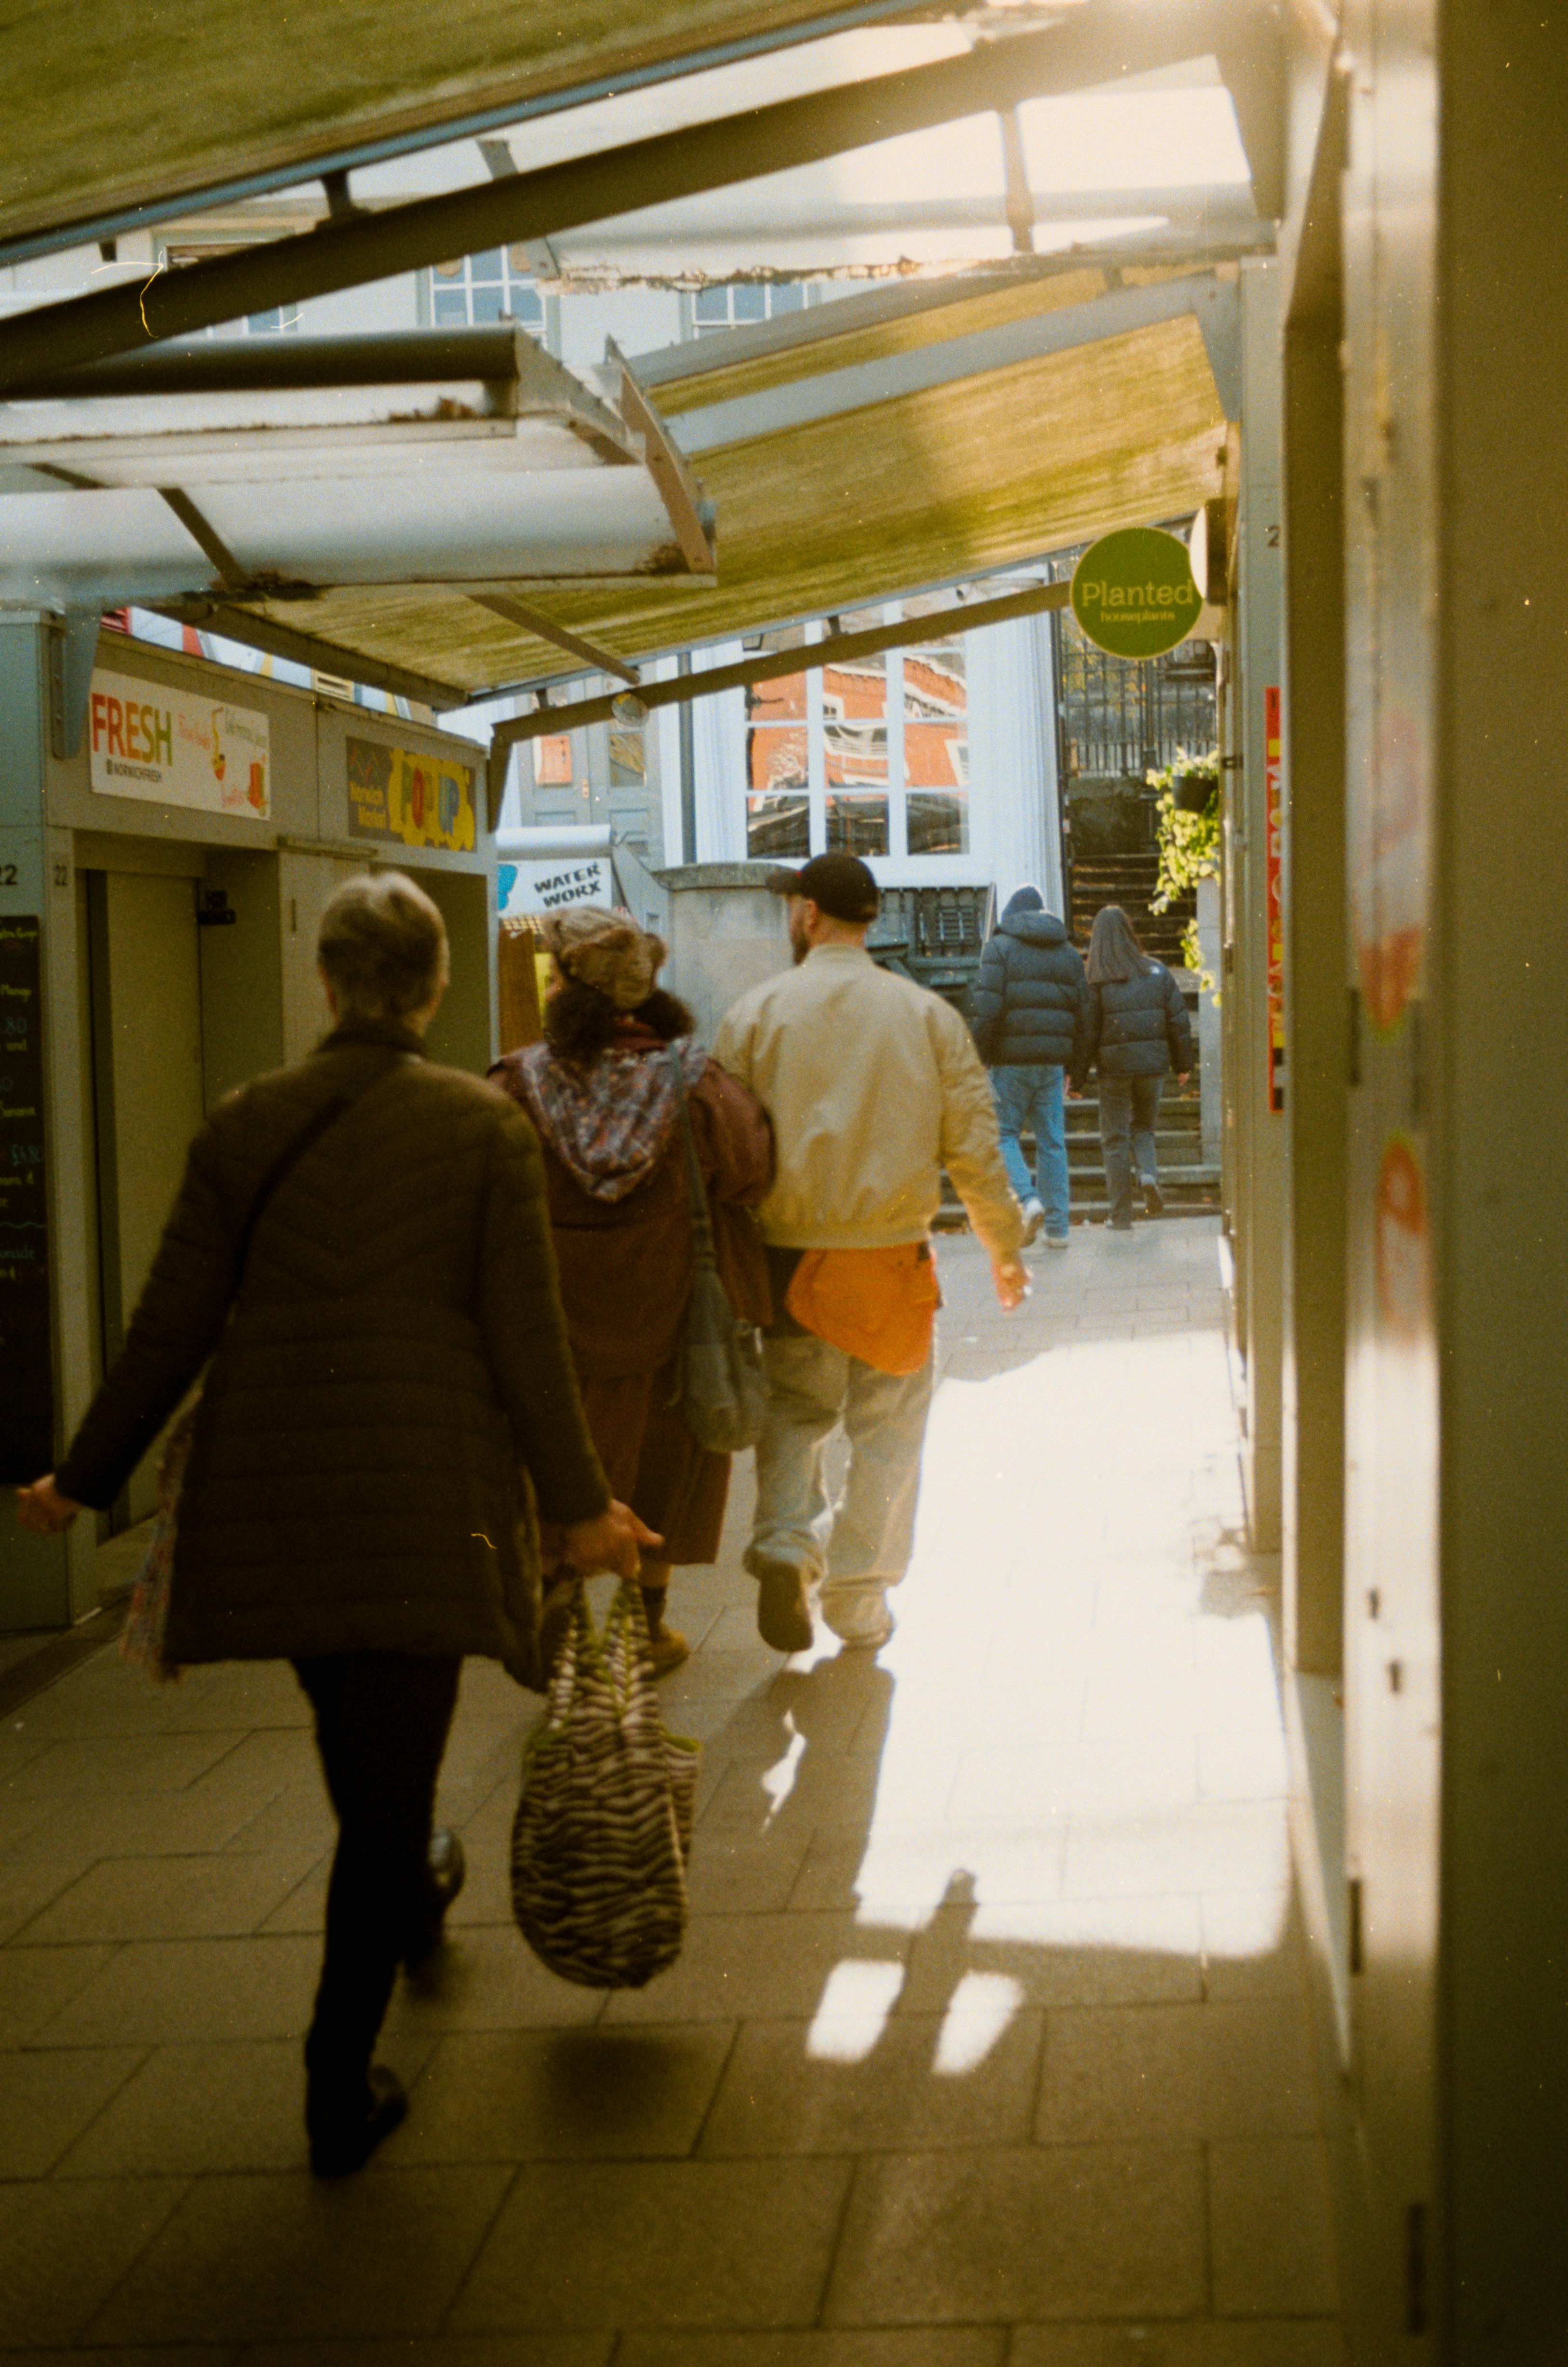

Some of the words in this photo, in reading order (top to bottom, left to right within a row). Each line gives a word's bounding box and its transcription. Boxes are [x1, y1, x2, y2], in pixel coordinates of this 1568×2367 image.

[1081, 579, 1193, 608] Planted
[1100, 610, 1176, 625] houseplants
[91, 692, 173, 766] FRESH
[54, 865, 68, 886] 22
[533, 860, 601, 893] WATER
[542, 881, 602, 908] WORX
